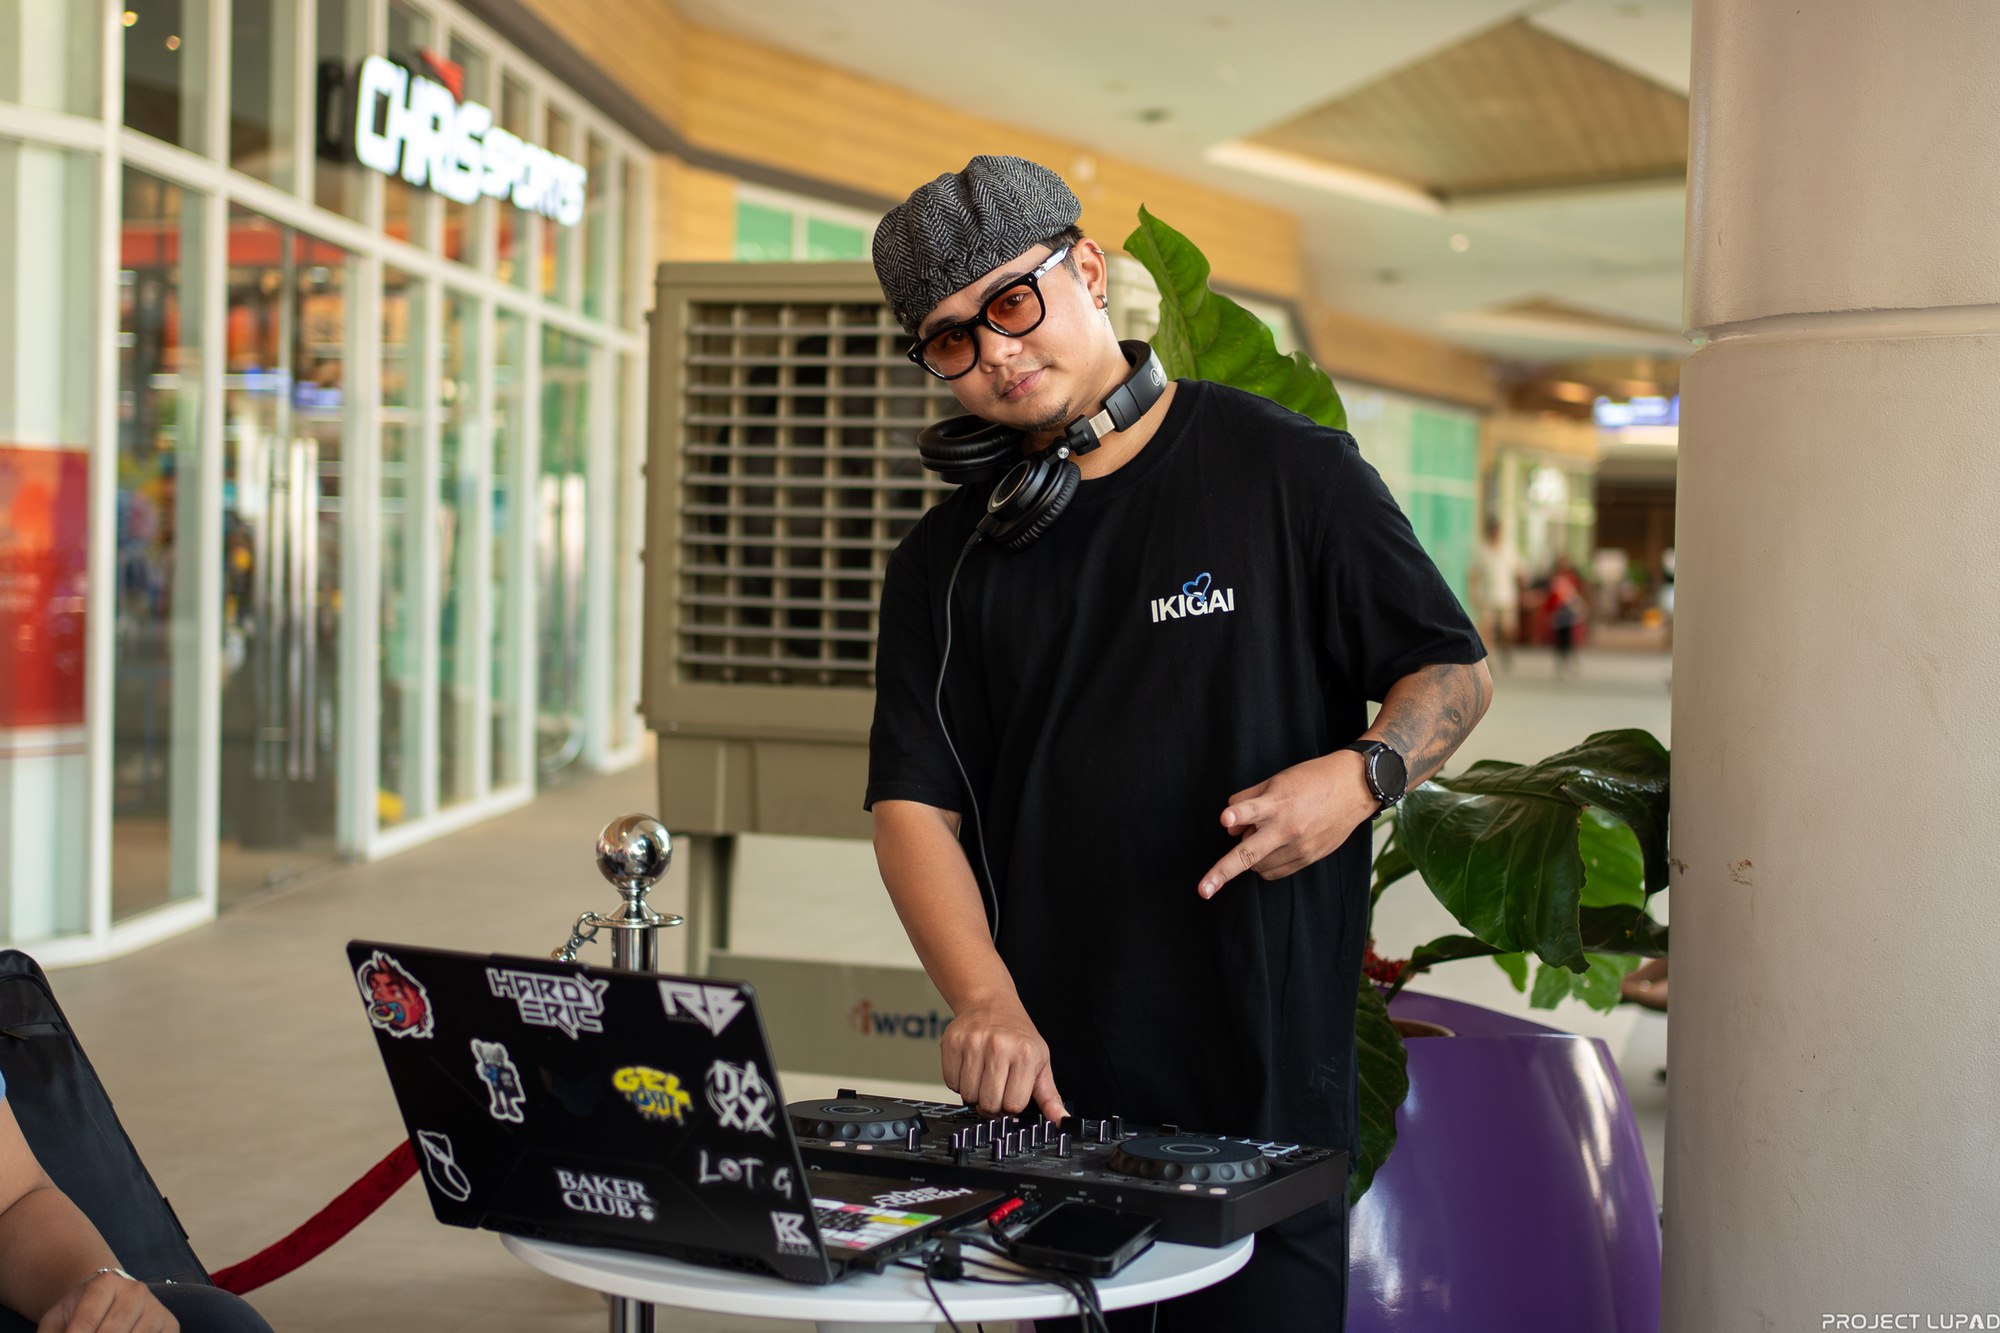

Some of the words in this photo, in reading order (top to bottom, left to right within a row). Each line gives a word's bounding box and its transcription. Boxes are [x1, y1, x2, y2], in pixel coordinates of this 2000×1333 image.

[480, 125, 588, 228] SPORTS
[1150, 587, 1235, 623] IKIGAI
[485, 967, 610, 1016] HARDY
[516, 998, 604, 1040] ERIC
[860, 1000, 955, 1040] iwat
[555, 1167, 653, 1203] BAKER
[562, 1190, 636, 1218] CLUB
